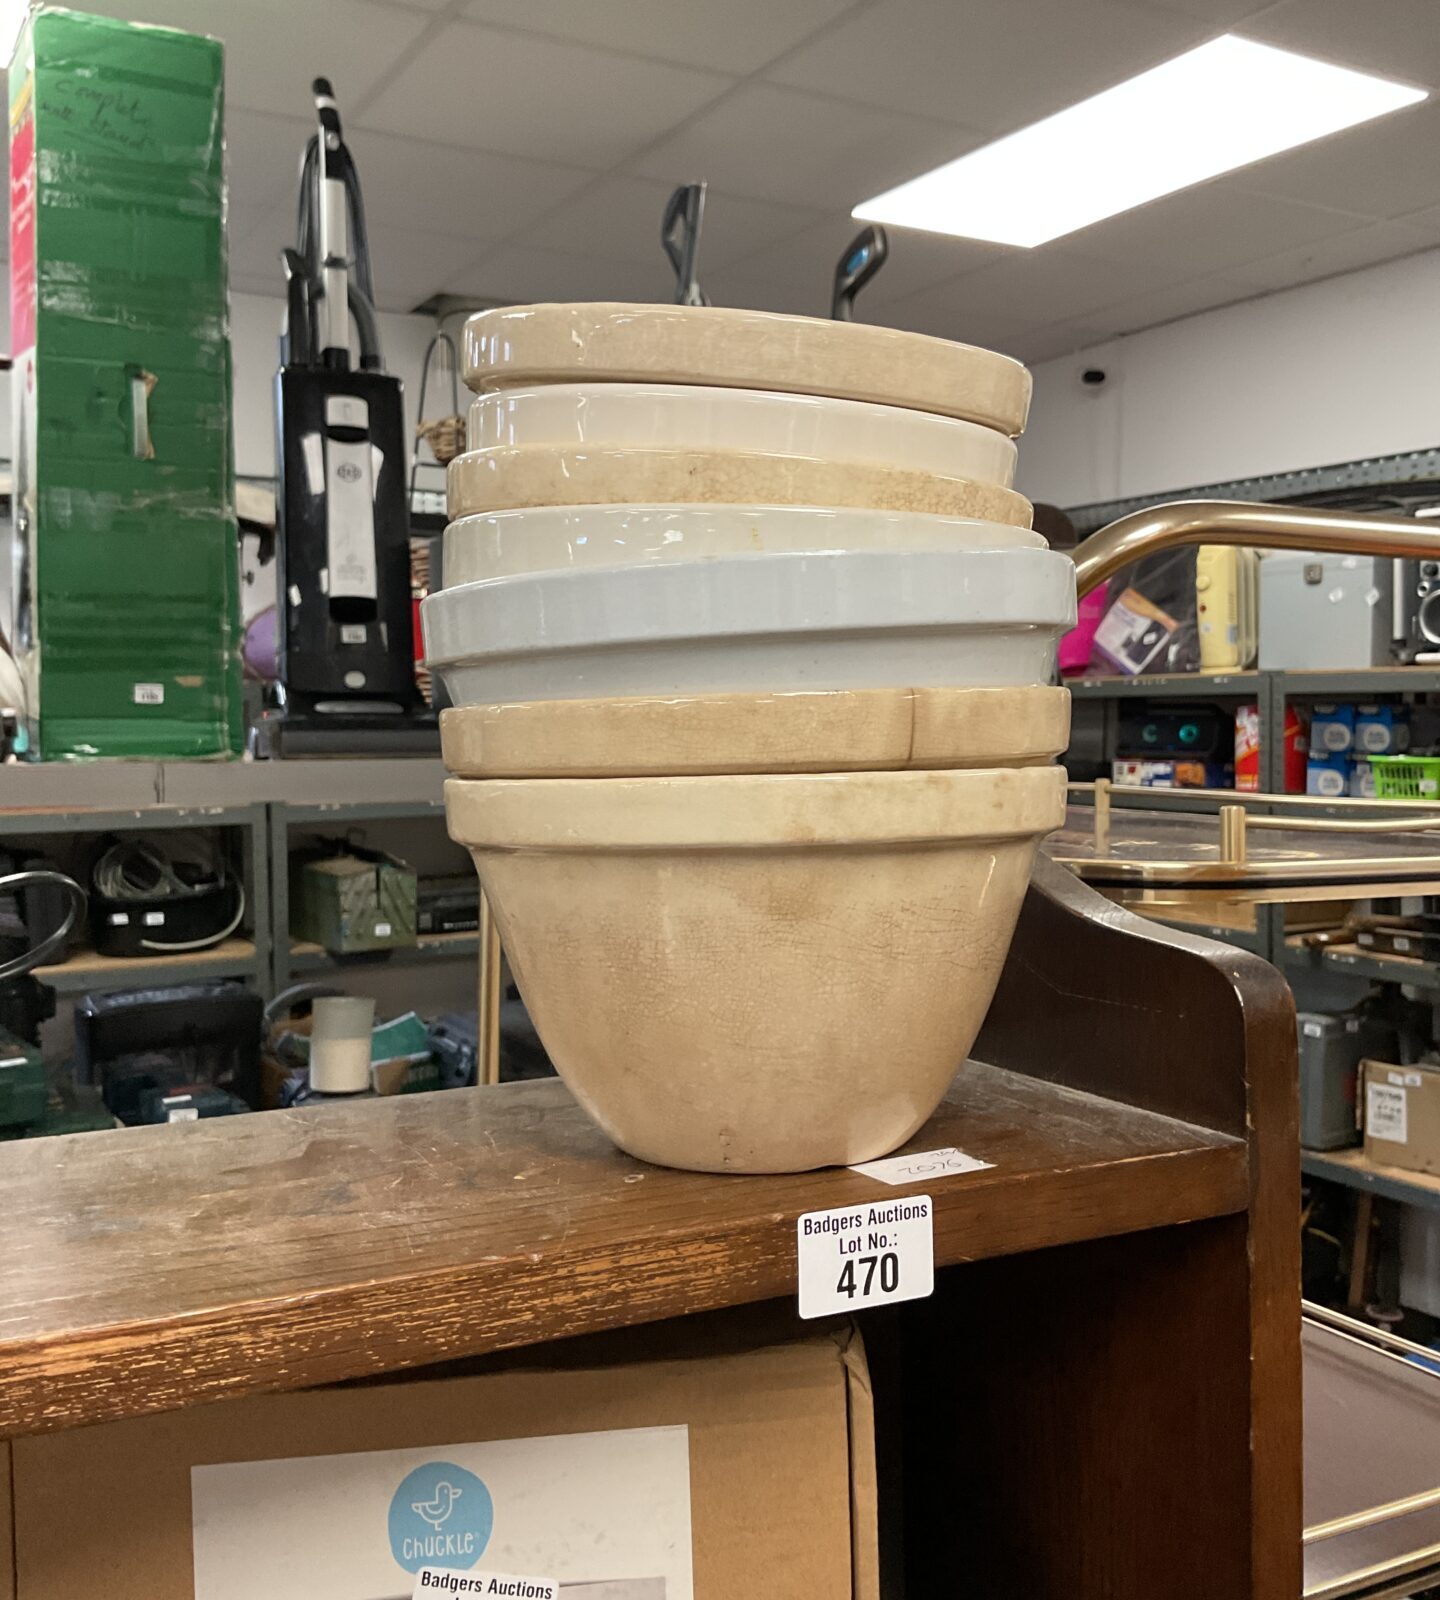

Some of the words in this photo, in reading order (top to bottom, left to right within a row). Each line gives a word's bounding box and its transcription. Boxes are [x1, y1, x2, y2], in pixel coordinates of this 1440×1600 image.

[804, 1214, 862, 1235] Badgers
[868, 1204, 928, 1225] Auctions
[839, 1236, 862, 1254] Lot
[868, 1232, 898, 1250] No.:
[836, 1252, 899, 1299] 470
[421, 1571, 483, 1593] Badgers
[487, 1578, 553, 1600] Auctions
